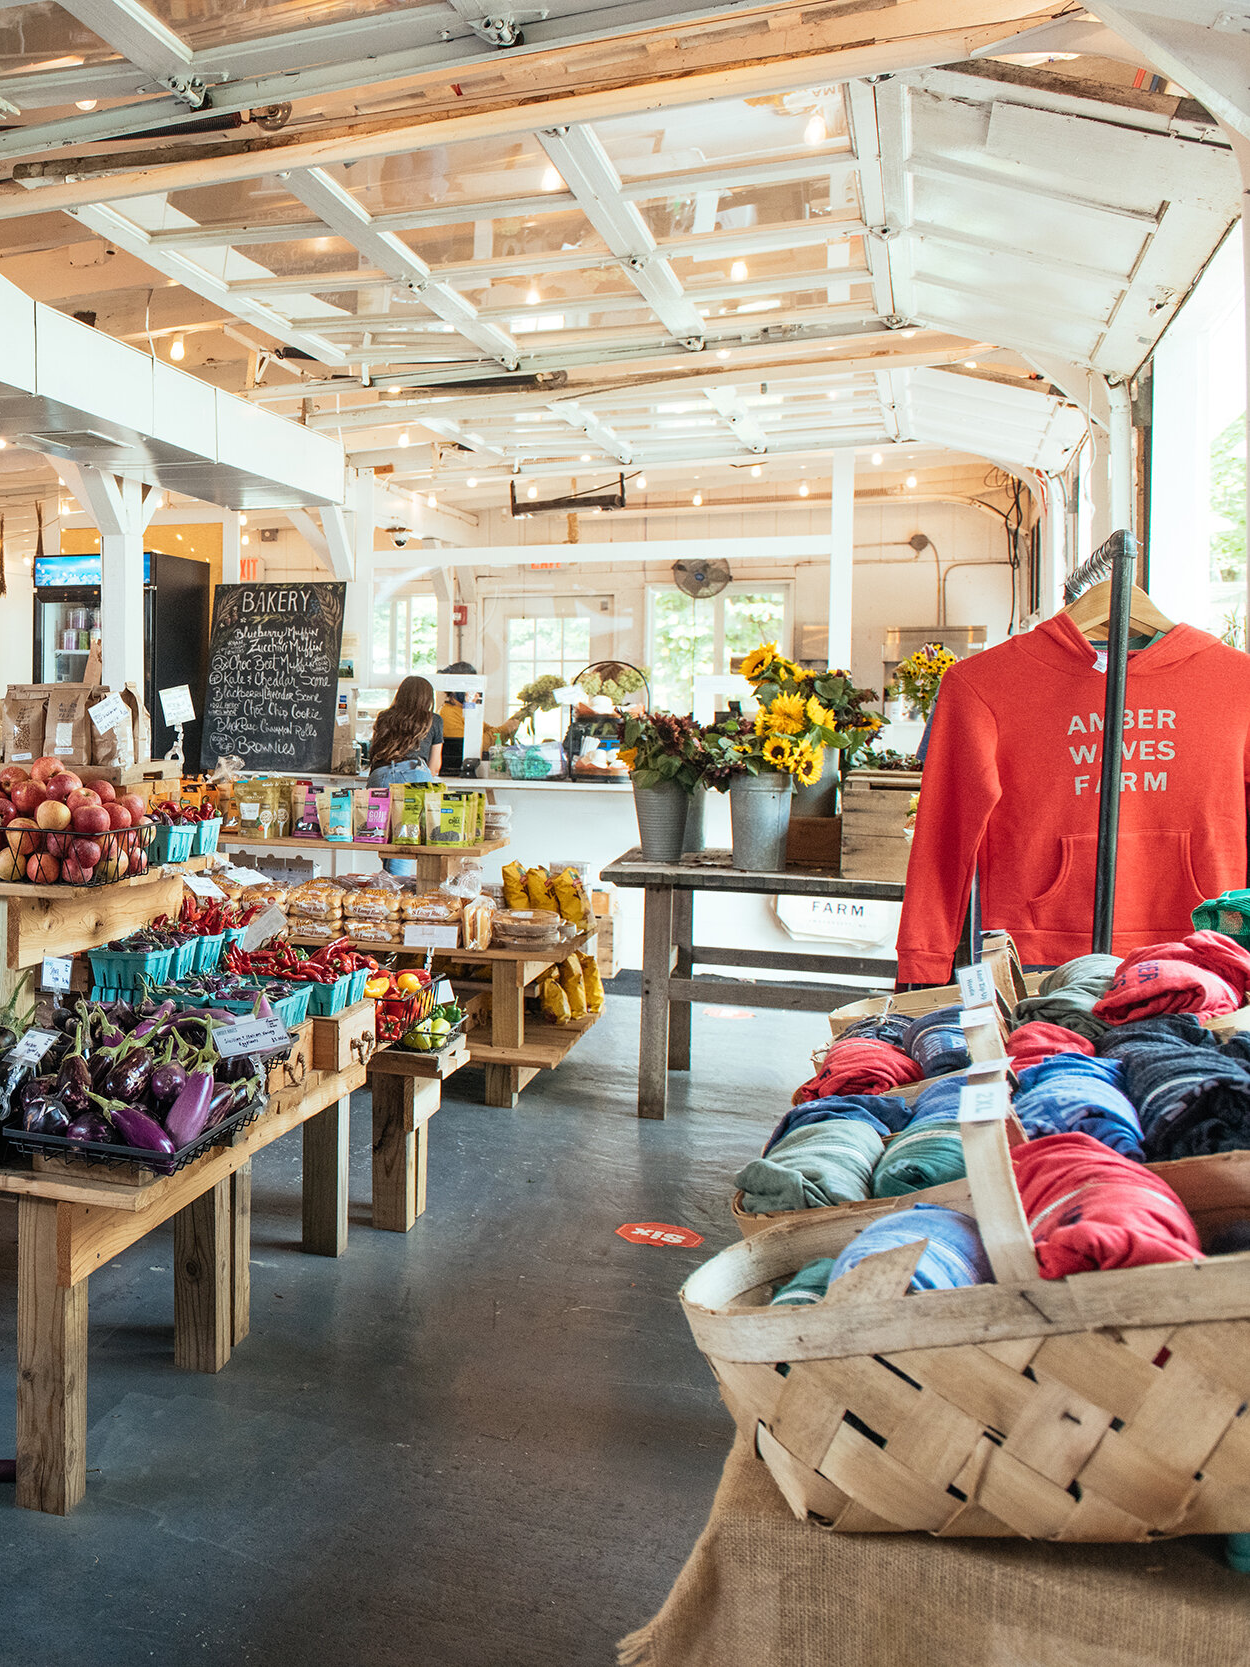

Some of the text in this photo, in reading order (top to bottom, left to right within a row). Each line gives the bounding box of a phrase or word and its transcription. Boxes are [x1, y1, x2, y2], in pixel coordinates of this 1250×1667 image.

[240, 558, 258, 580] XIT
[242, 590, 311, 613] BAKERY
[234, 624, 318, 644] Blueberry Muffin
[246, 638, 288, 654] Zucchini
[289, 639, 323, 658] Muffin
[230, 654, 251, 671] Choc
[252, 654, 280, 671] Beet
[280, 654, 314, 674] Muffin
[224, 671, 246, 688] Kale
[254, 671, 298, 688] Cheddar
[299, 673, 331, 687] Scone
[295, 689, 322, 703] Scone
[244, 699, 265, 717] Choc
[268, 702, 288, 719] Chip
[291, 704, 322, 720] Cookie
[293, 723, 317, 741] Rolls
[1067, 709, 1176, 735] AMBER
[1069, 740, 1176, 765] WVES
[1074, 771, 1167, 795] FRM
[812, 901, 864, 917] FARM
[975, 1092, 994, 1113] 2XL
